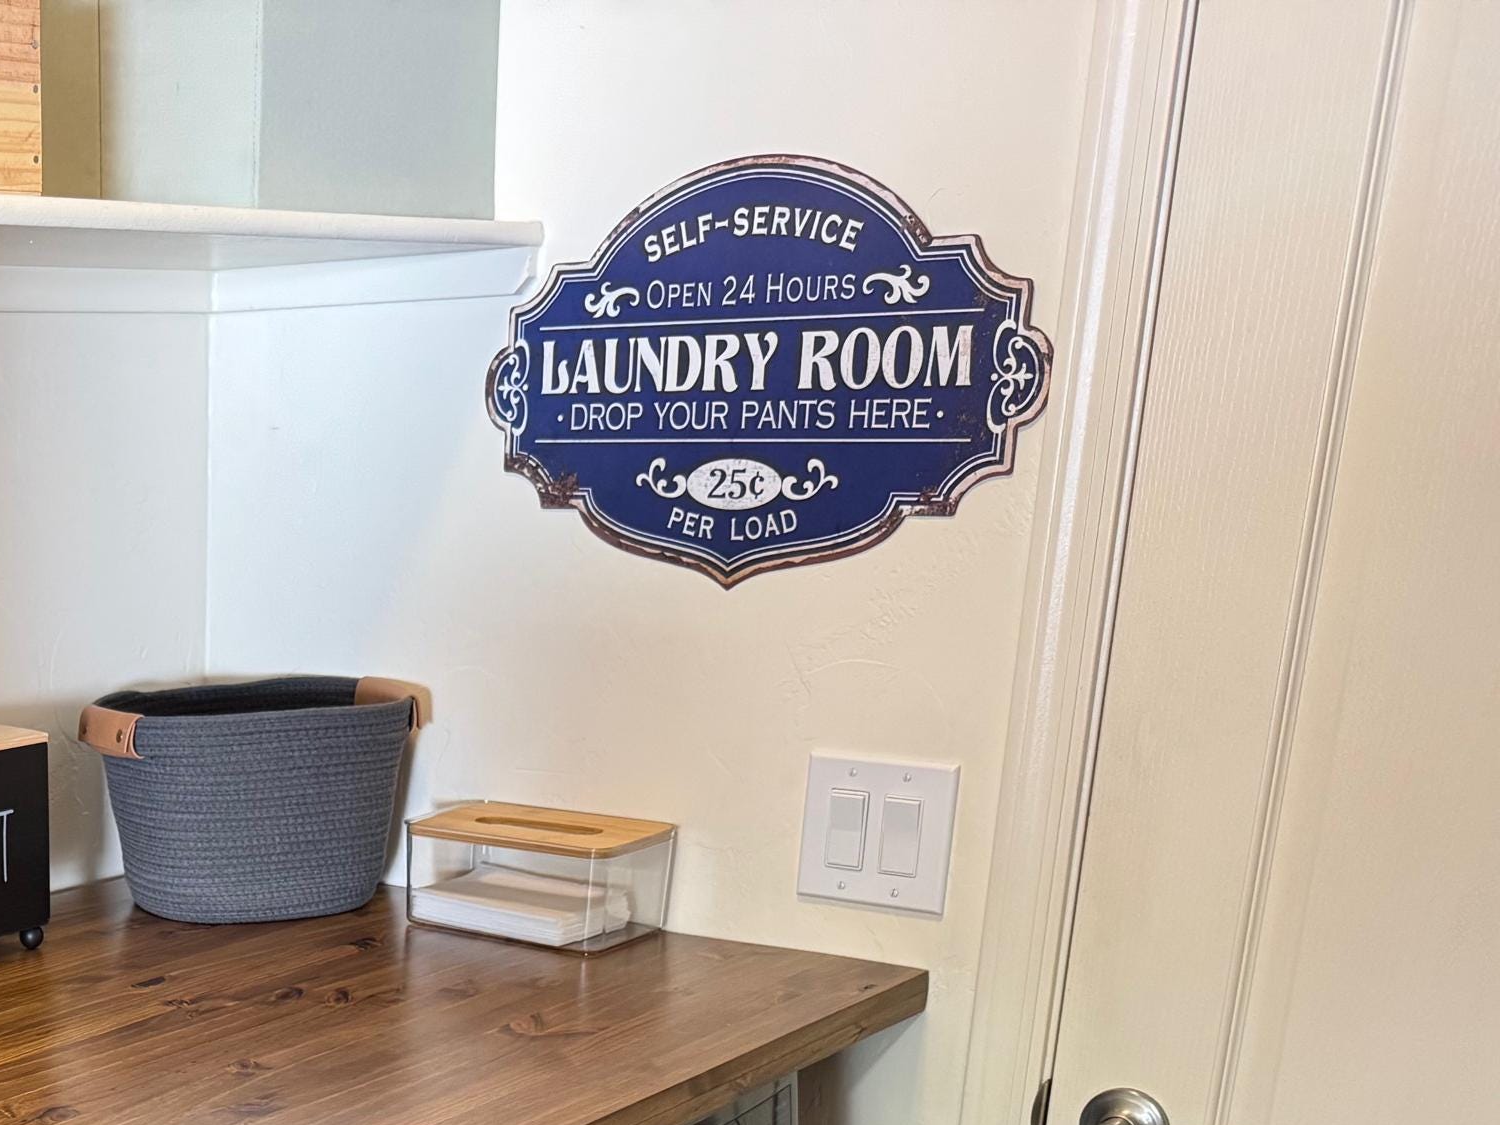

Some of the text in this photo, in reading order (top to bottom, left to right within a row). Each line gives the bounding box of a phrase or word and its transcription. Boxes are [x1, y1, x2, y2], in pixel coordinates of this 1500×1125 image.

[644, 205, 864, 263] SELF-SERVICE
[722, 276, 756, 306] 24
[541, 325, 974, 395] LAUNDRY ROOM
[571, 398, 932, 432] DROP YOUR PANTS HERE
[708, 467, 766, 500] 25¢
[667, 507, 798, 542] PER LOAD
